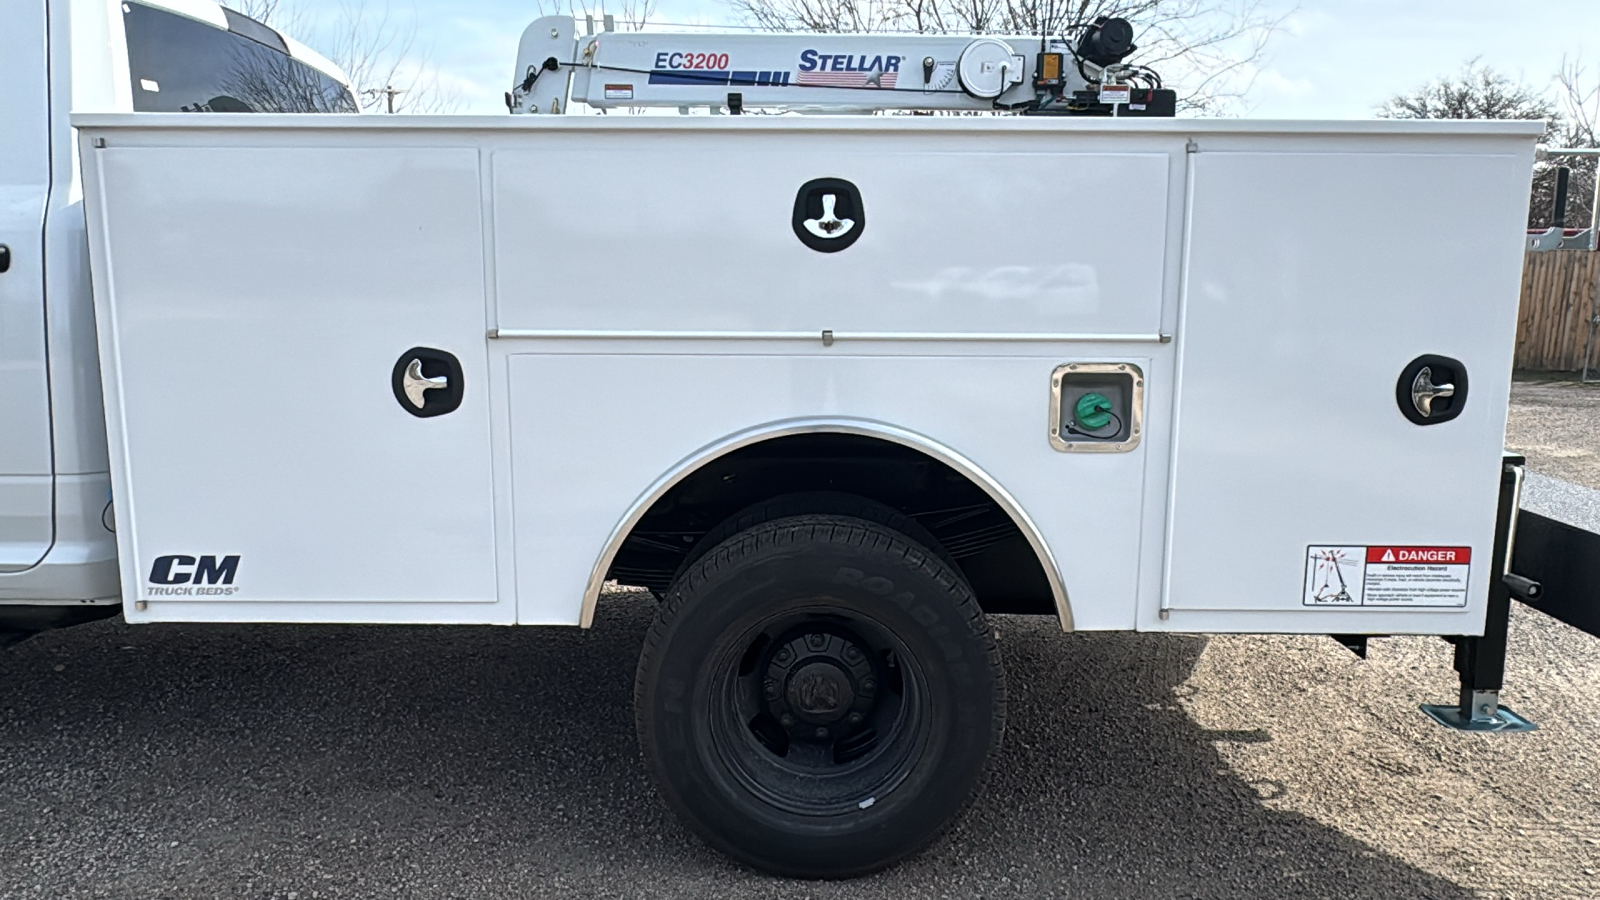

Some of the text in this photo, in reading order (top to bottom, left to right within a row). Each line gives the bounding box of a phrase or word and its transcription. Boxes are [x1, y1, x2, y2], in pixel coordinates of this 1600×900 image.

[654, 52, 729, 70] EC3200
[798, 49, 901, 72] STELLAR
[1398, 550, 1456, 561] DANGER
[148, 554, 241, 585] CM
[147, 586, 193, 596] TRUCK
